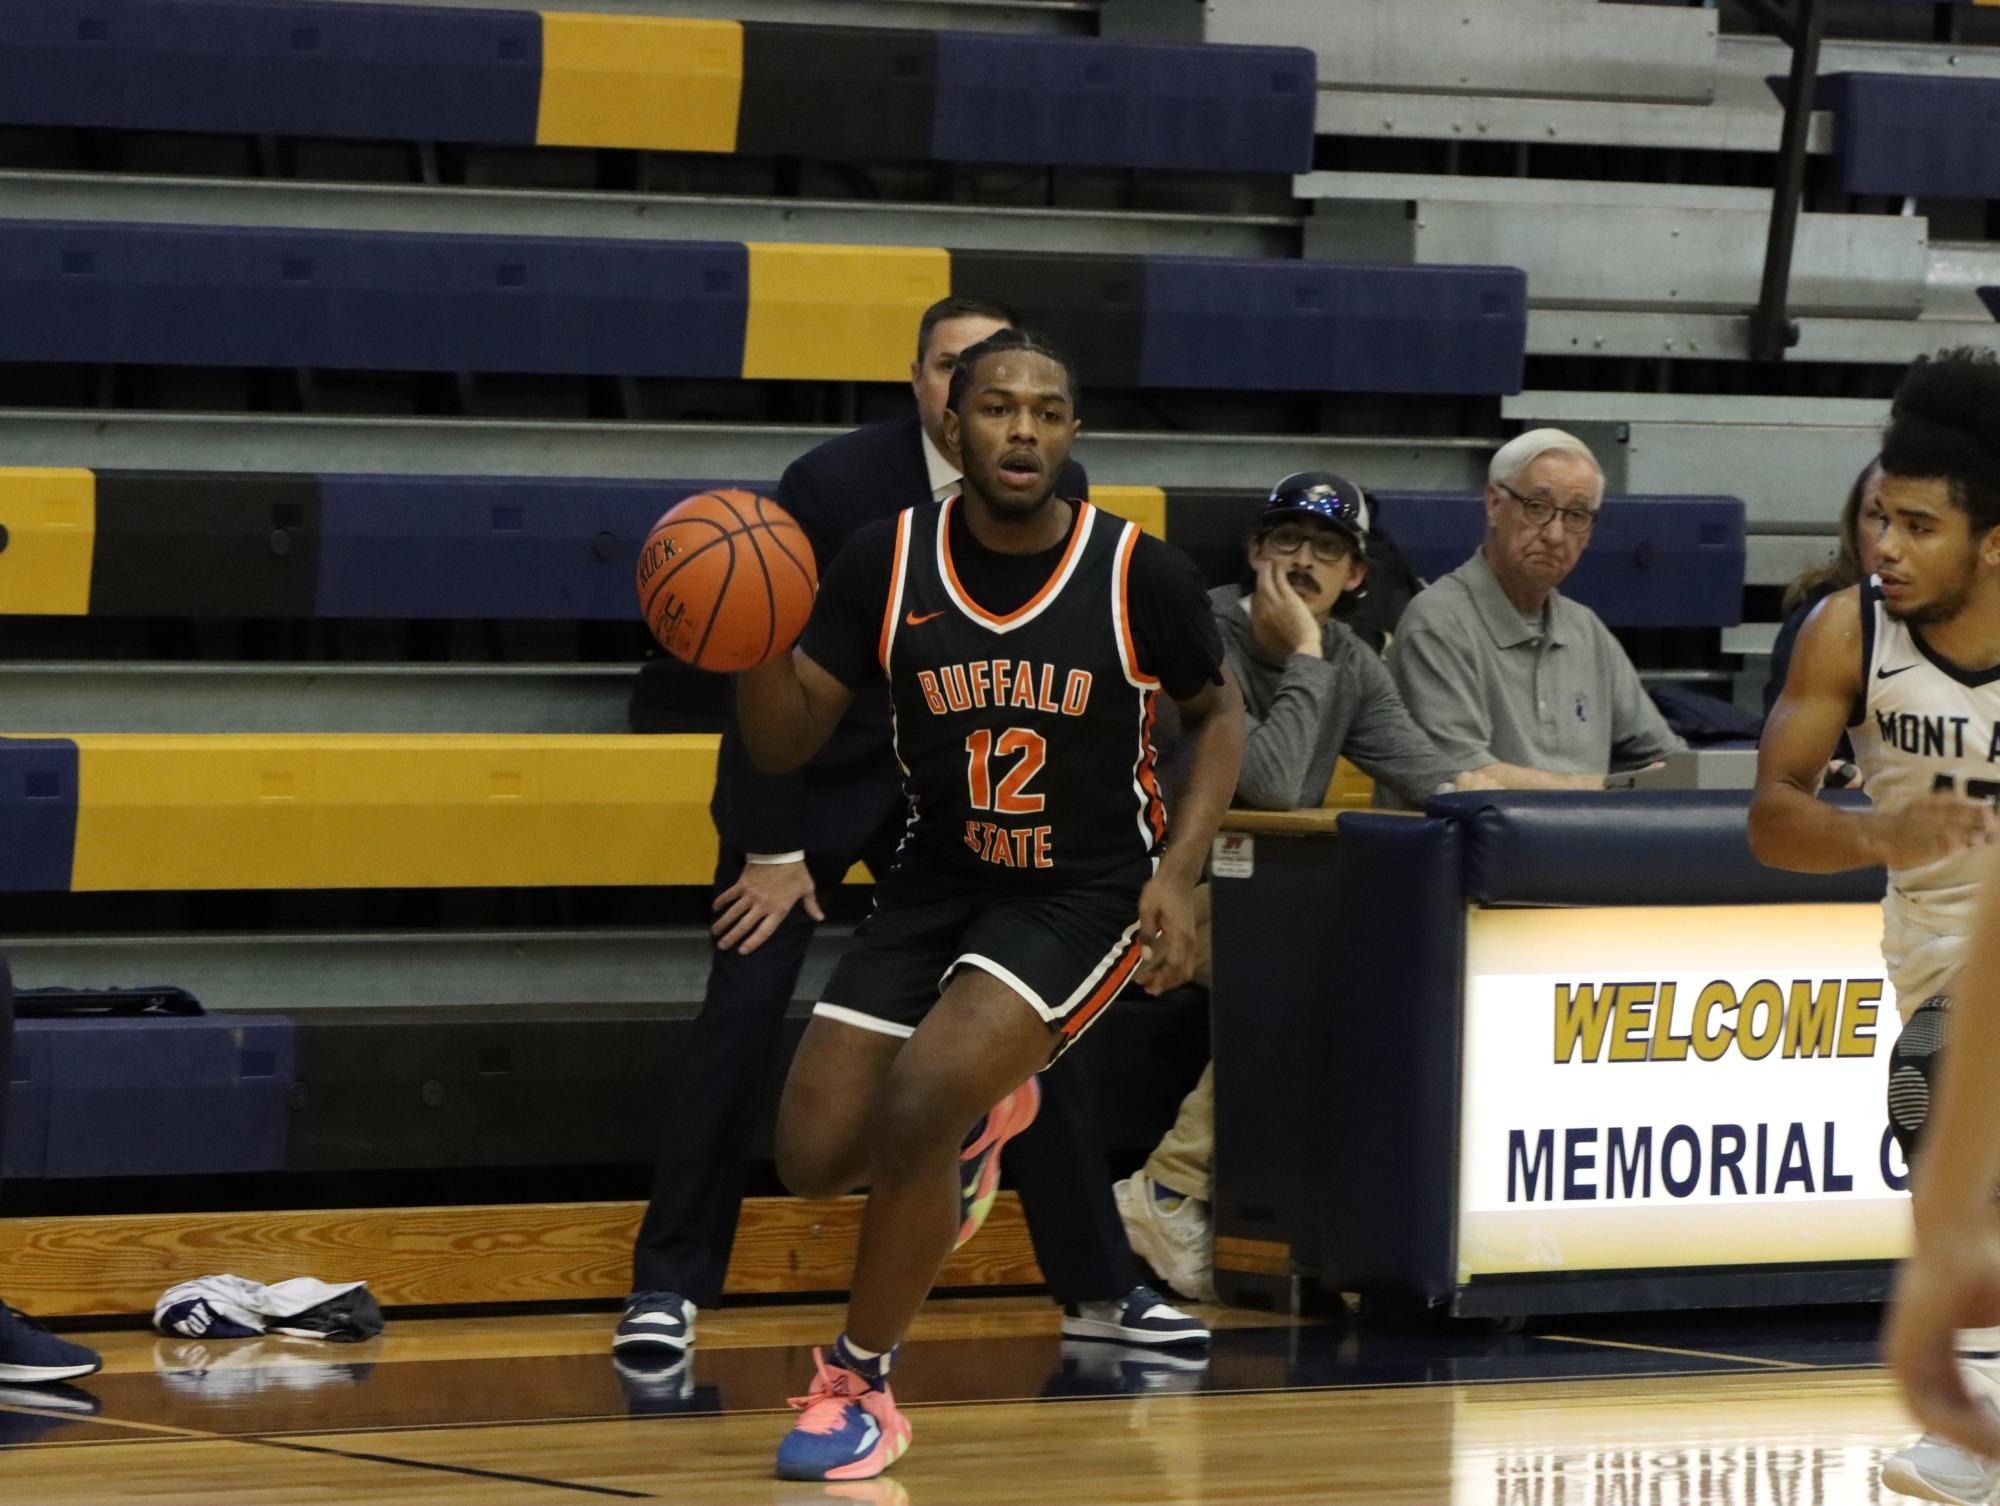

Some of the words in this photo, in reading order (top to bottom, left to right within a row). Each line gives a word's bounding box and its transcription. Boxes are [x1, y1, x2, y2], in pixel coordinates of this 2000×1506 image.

[917, 659, 1092, 716] BUFFALO
[1875, 708, 1969, 759] MONT
[964, 727, 1047, 815] 12
[963, 820, 1054, 868] STATE
[1554, 978, 1884, 1064] WELCOME
[1506, 1121, 1854, 1203] MEMORIAL
